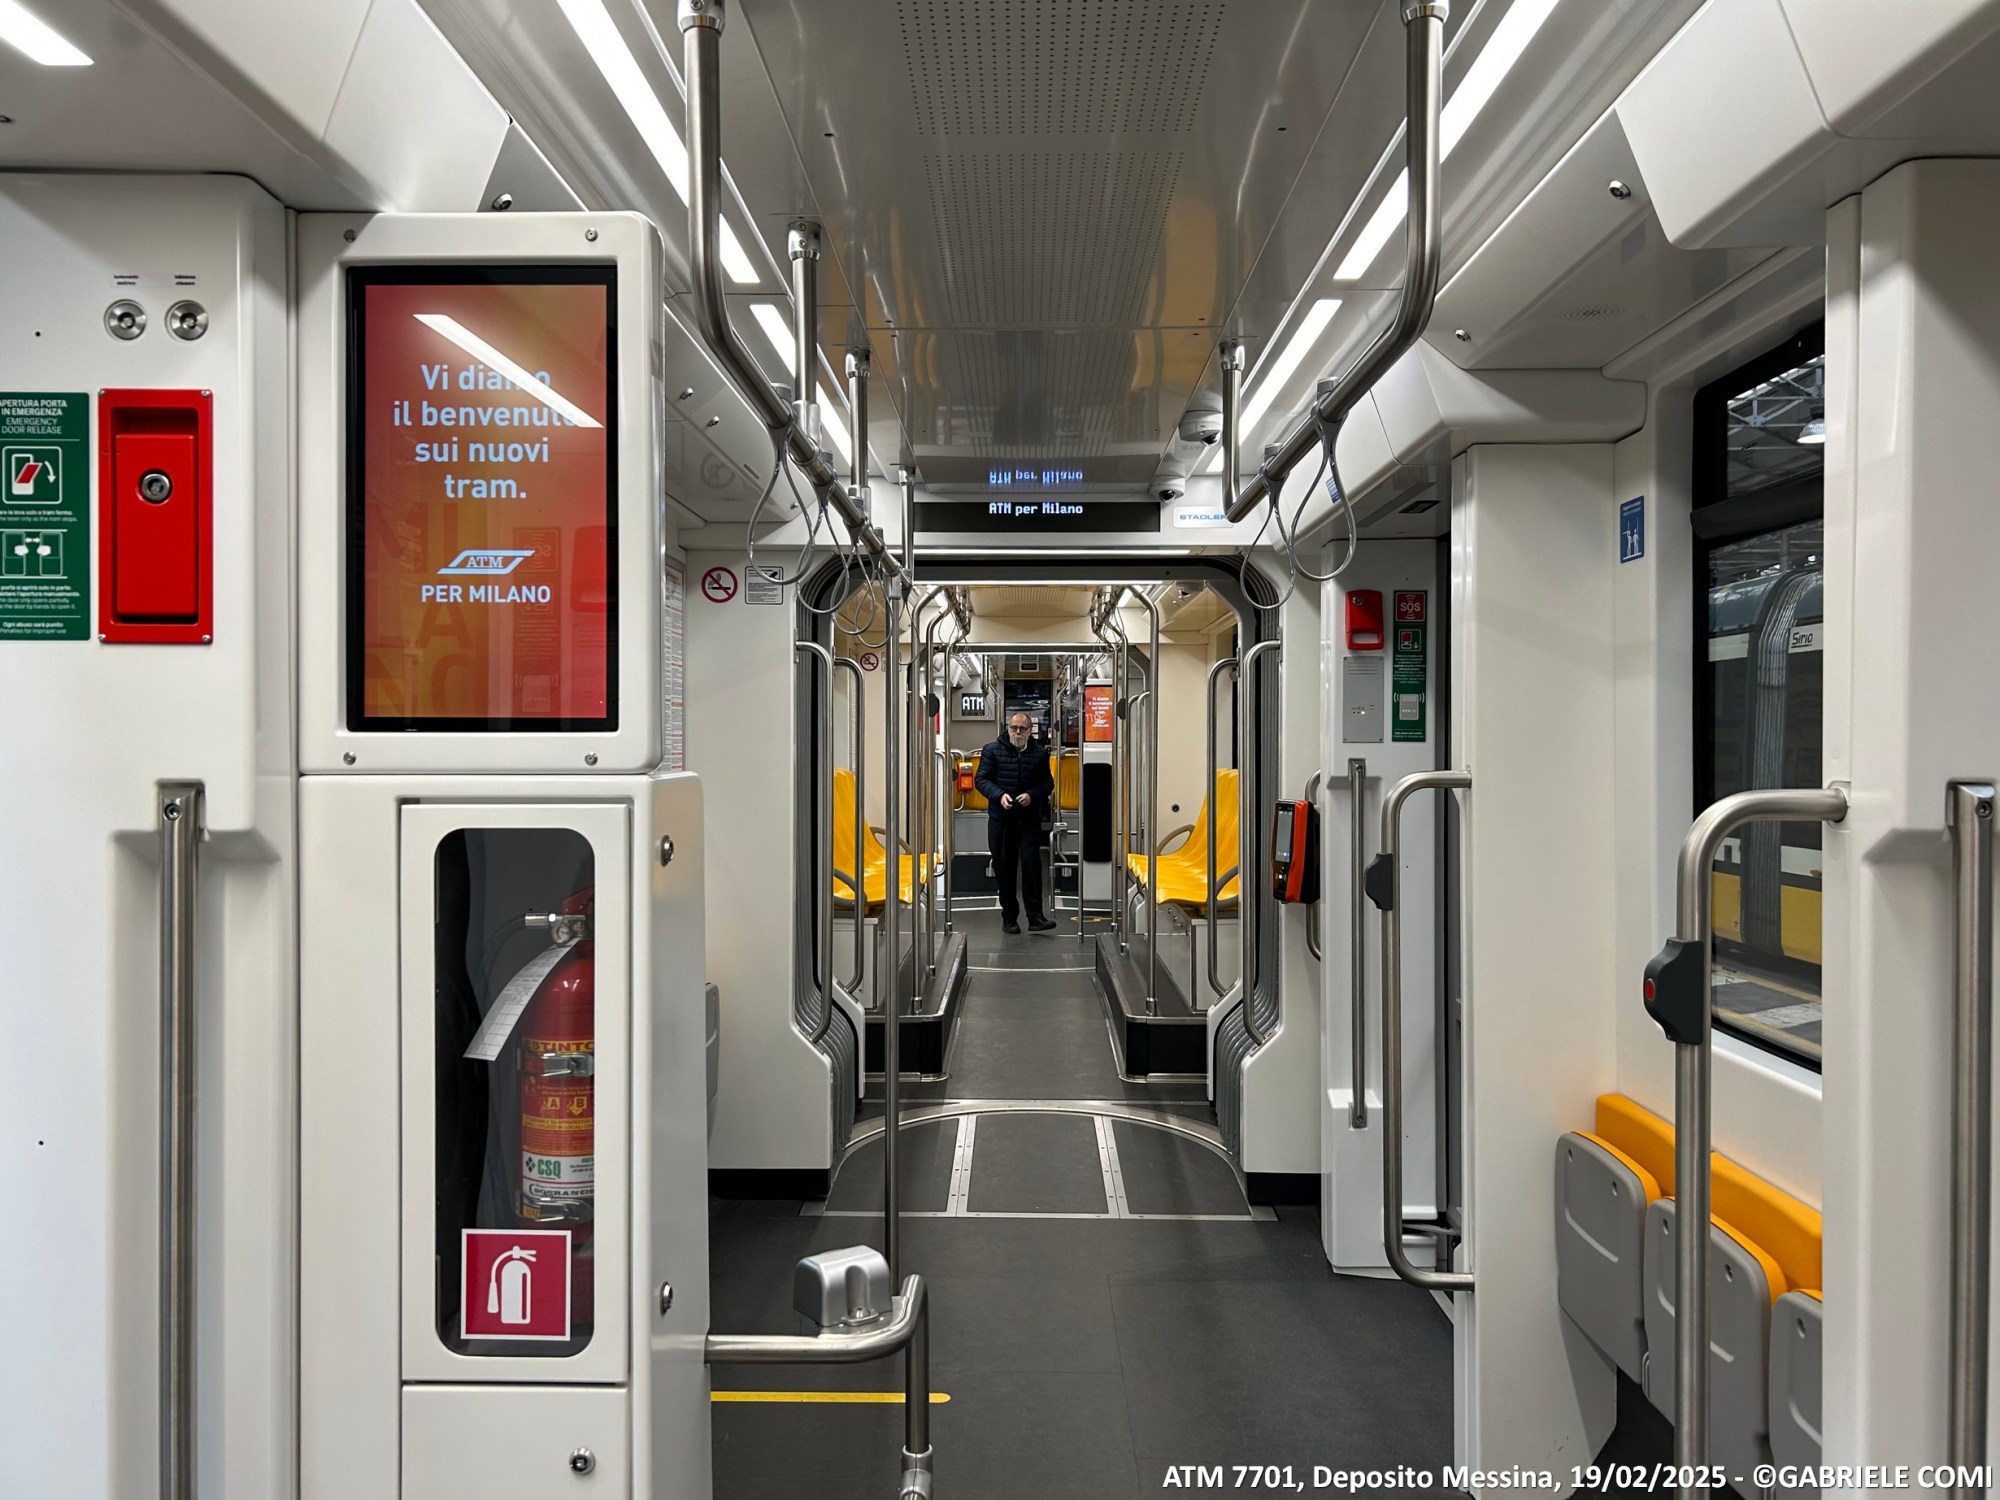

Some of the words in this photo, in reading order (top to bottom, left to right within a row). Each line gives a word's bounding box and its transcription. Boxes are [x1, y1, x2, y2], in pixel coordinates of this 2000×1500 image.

[421, 365, 448, 390] Vi
[40, 399, 67, 408] PORTA
[1, 407, 10, 416] IN
[11, 407, 63, 416] EMERGENZA
[393, 401, 413, 426] il
[5, 417, 58, 426] EMERGENCY
[1, 425, 26, 434] DOOR
[26, 425, 63, 435] RELEASE
[415, 436, 458, 462] sui
[469, 436, 549, 463] nuovi
[444, 474, 527, 498] tram.
[989, 502, 1012, 514] ATM
[1015, 504, 1039, 517] per
[1042, 502, 1084, 514] Milano
[466, 556, 504, 568] ATM
[421, 585, 463, 603] PER
[469, 585, 551, 603] MILANO
[1400, 602, 1421, 611] SOS
[962, 696, 984, 710] ATM
[538, 1158, 561, 1179] CSQ
